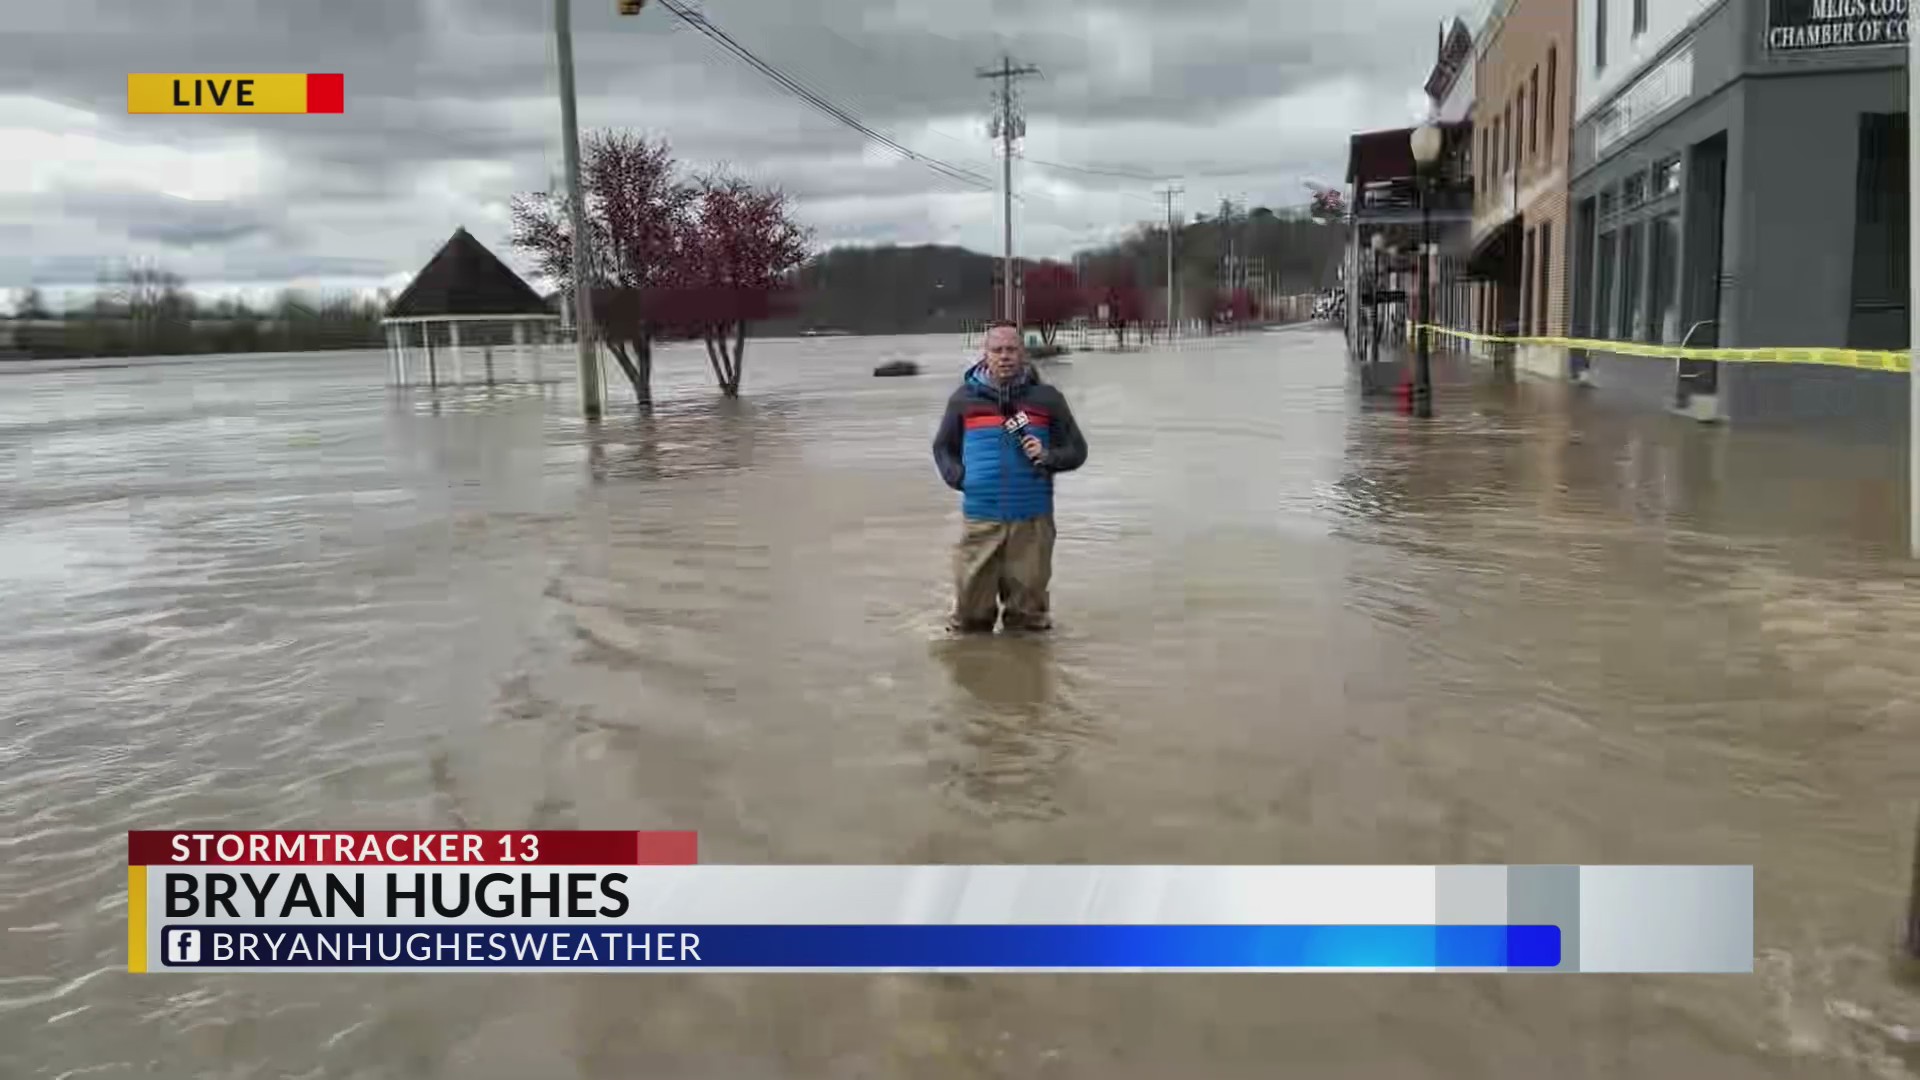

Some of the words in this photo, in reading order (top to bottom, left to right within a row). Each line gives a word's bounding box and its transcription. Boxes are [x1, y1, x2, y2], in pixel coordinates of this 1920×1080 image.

[1812, 0, 1866, 19] MEIGS
[1770, 23, 1854, 48] CHAMBER
[1858, 20, 1883, 42] OF
